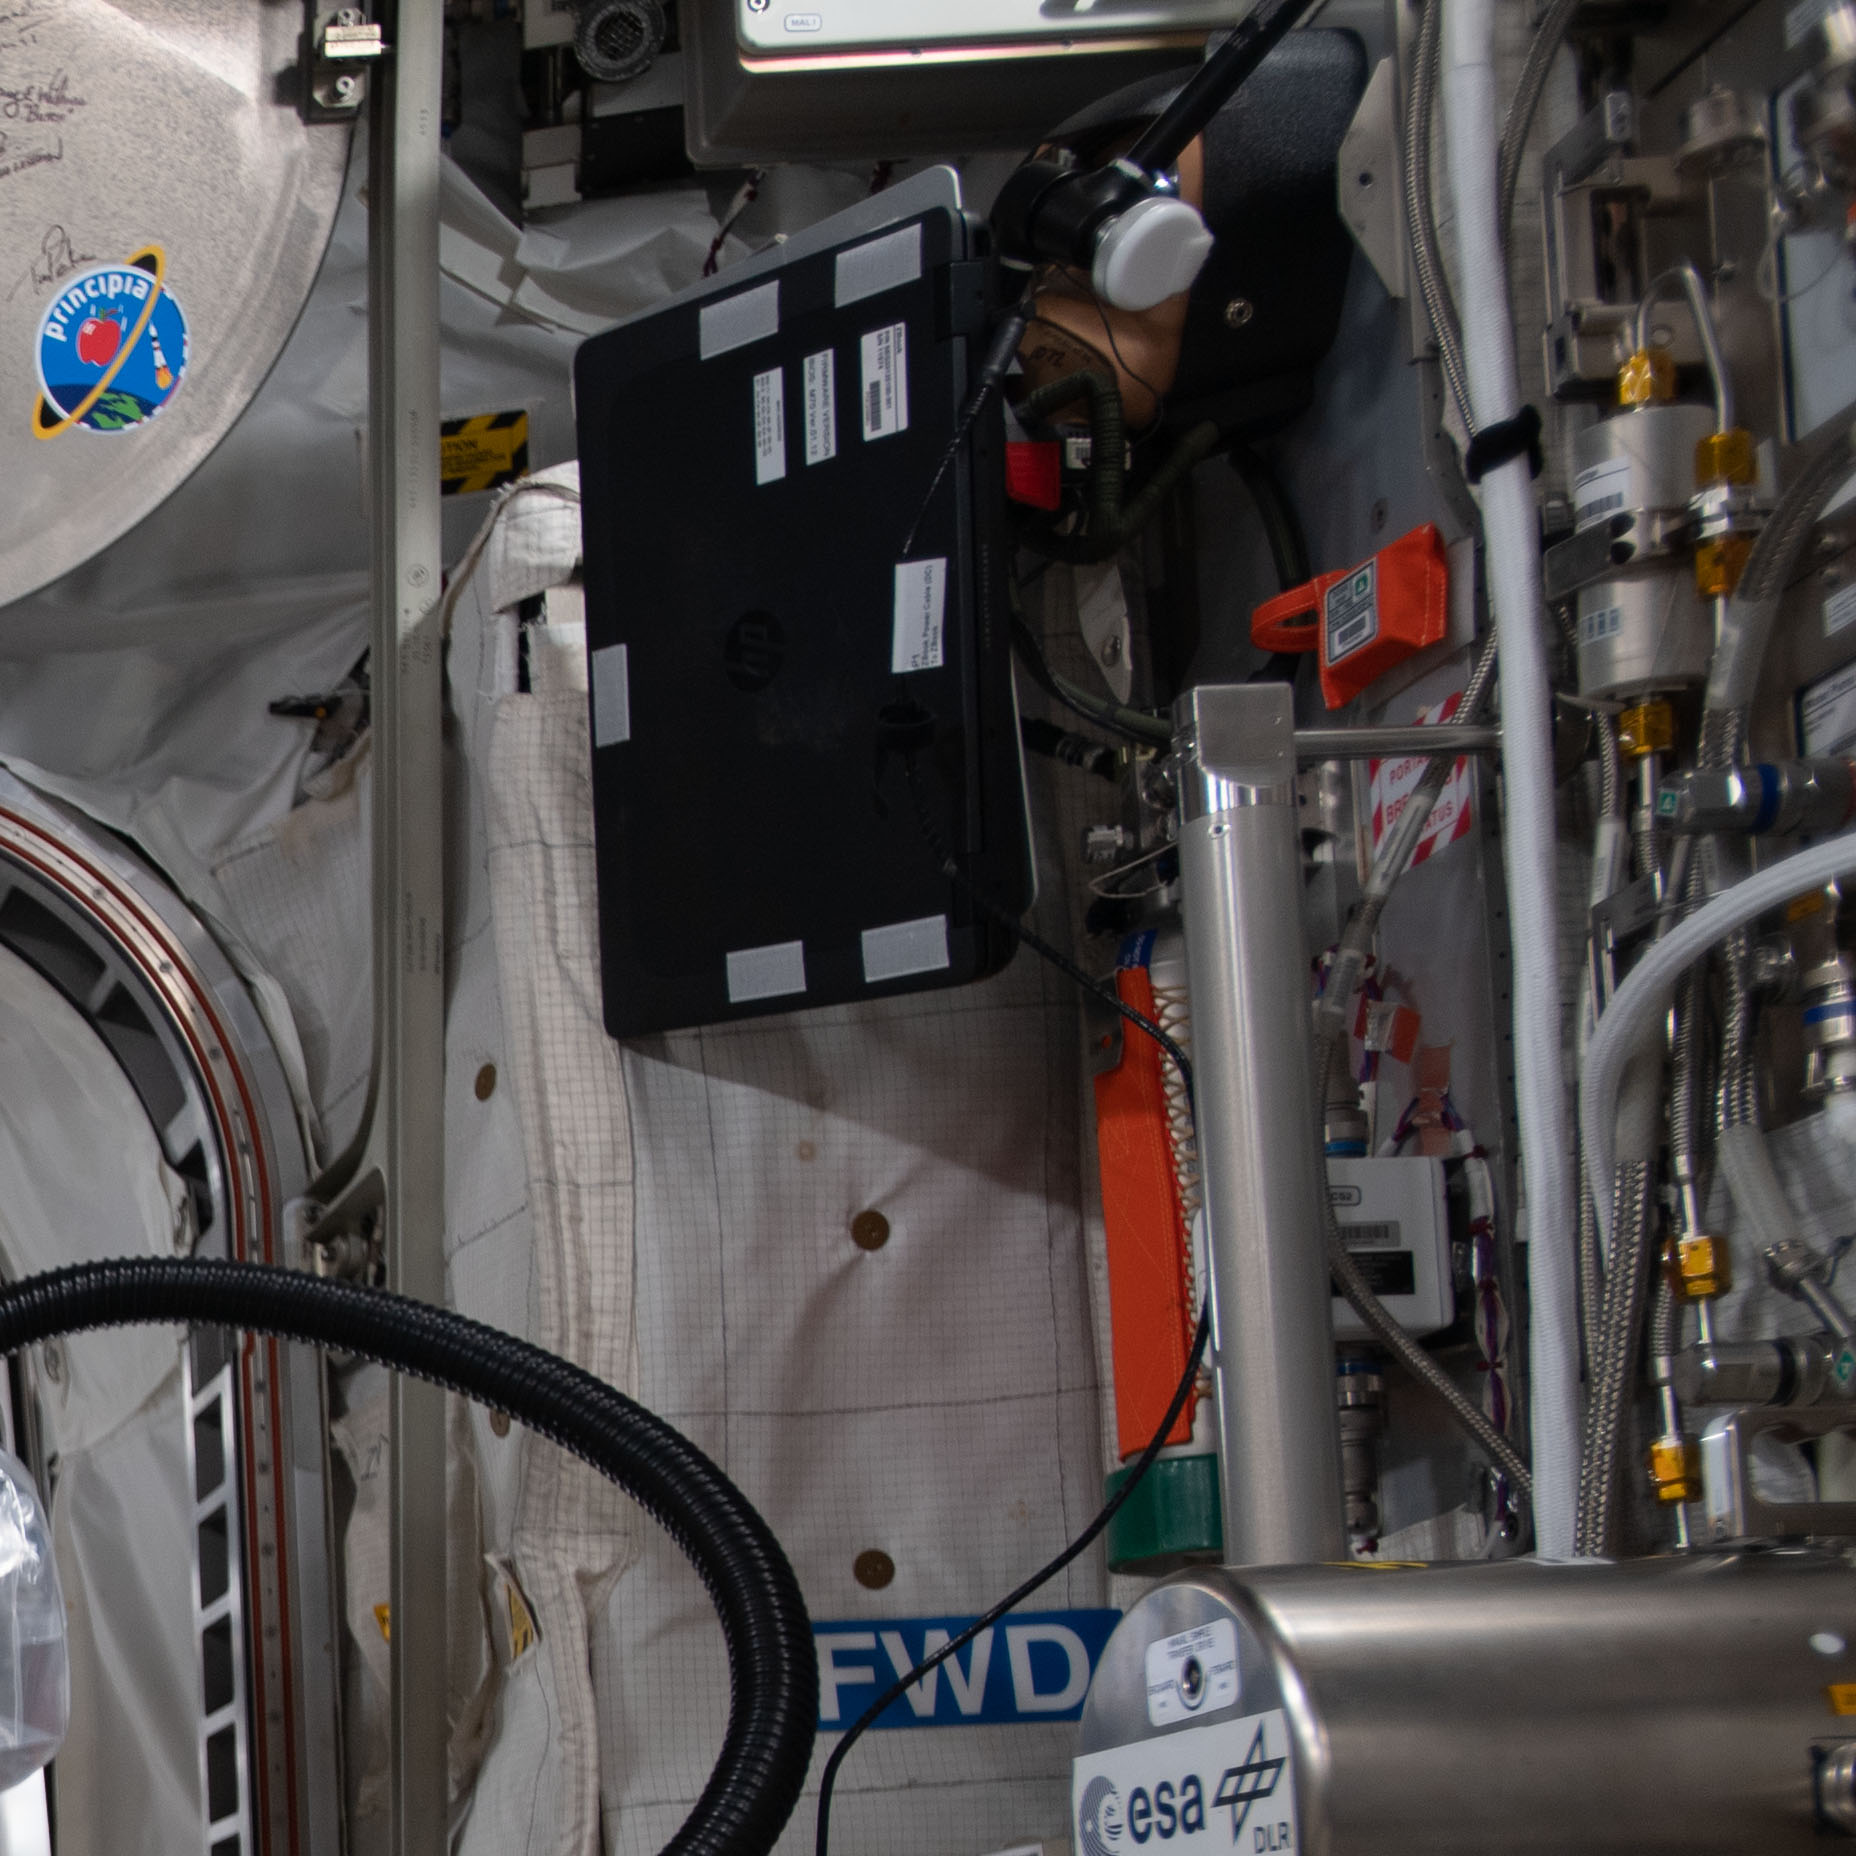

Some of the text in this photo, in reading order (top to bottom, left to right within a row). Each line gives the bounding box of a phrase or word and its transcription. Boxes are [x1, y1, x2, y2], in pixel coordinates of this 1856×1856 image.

[44, 272, 150, 343] principia
[822, 352, 831, 458] FIRMWARE VERSION
[820, 1624, 1092, 1723] FWD
[1128, 1773, 1206, 1845] esa
[1254, 1820, 1288, 1855] DLR
